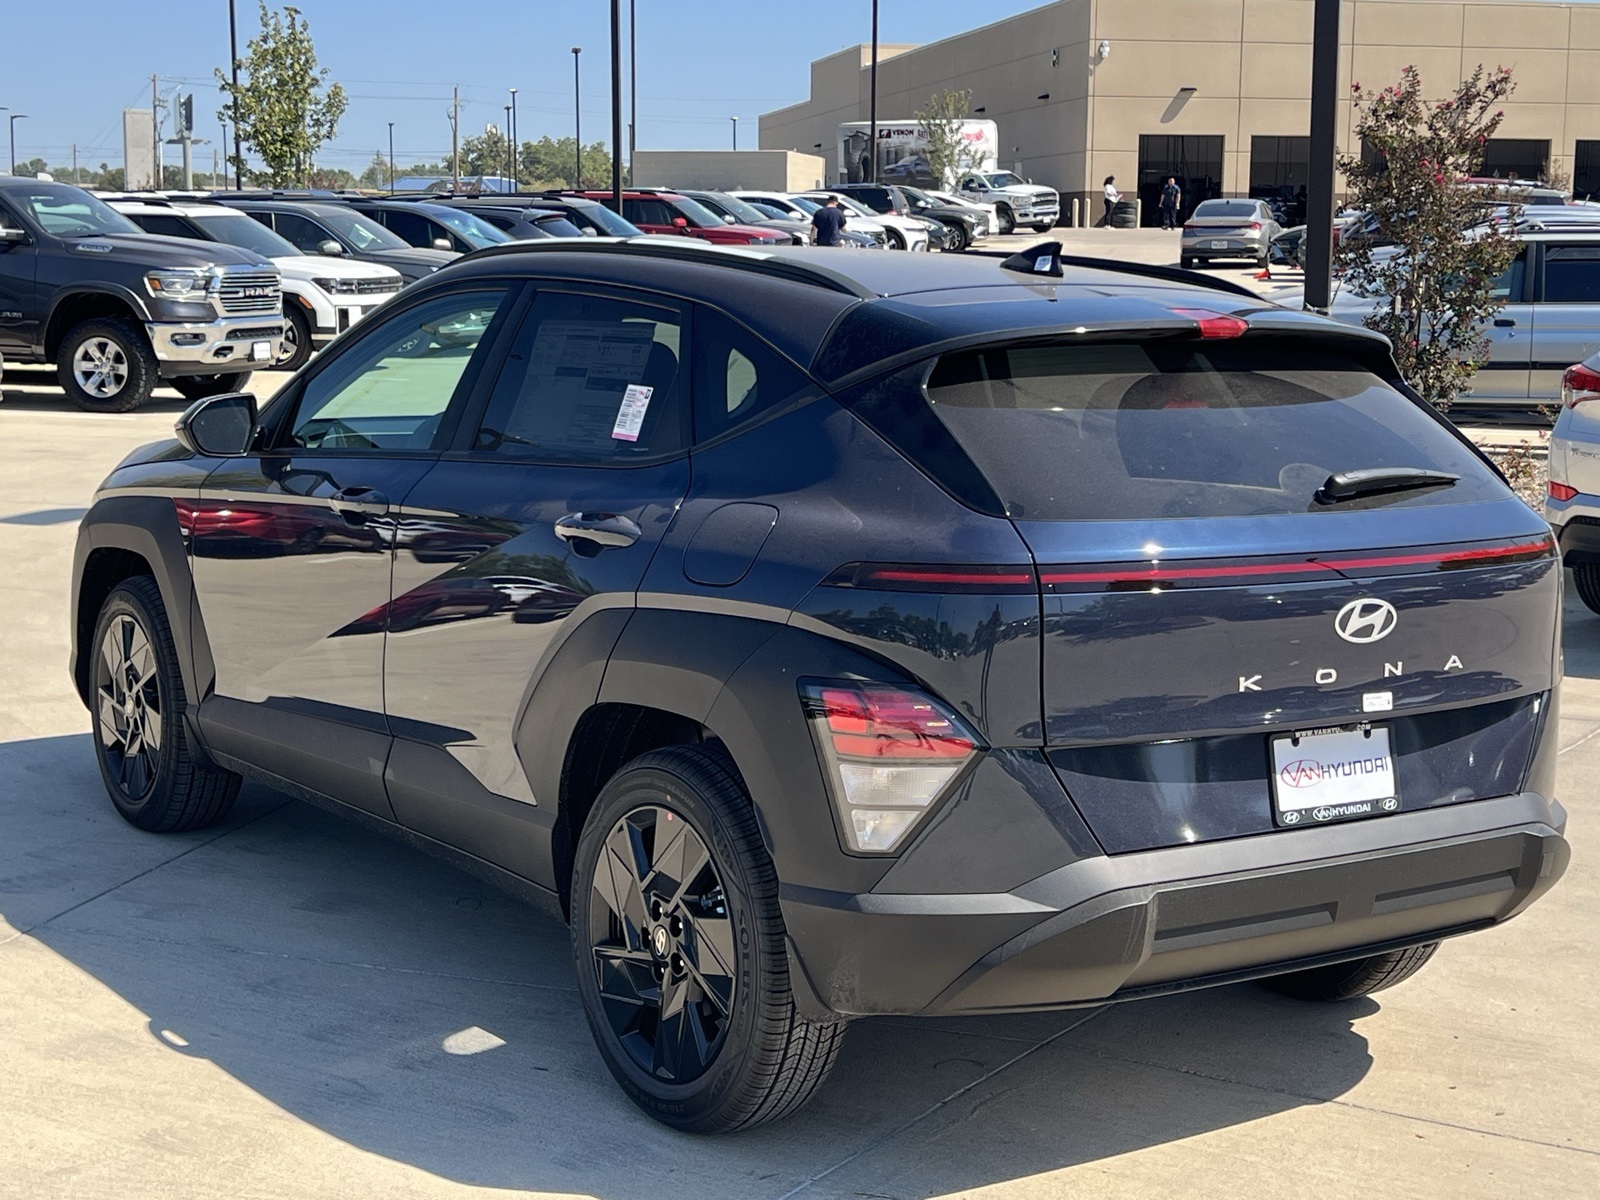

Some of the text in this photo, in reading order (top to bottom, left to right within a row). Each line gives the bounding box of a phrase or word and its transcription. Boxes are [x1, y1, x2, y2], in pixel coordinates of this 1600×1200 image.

[245, 287, 273, 296] RAM
[1238, 655, 1464, 692] KONA
[1295, 724, 1371, 738] WWW.VANHYU.COM
[738, 908, 750, 1007] SOLUS
